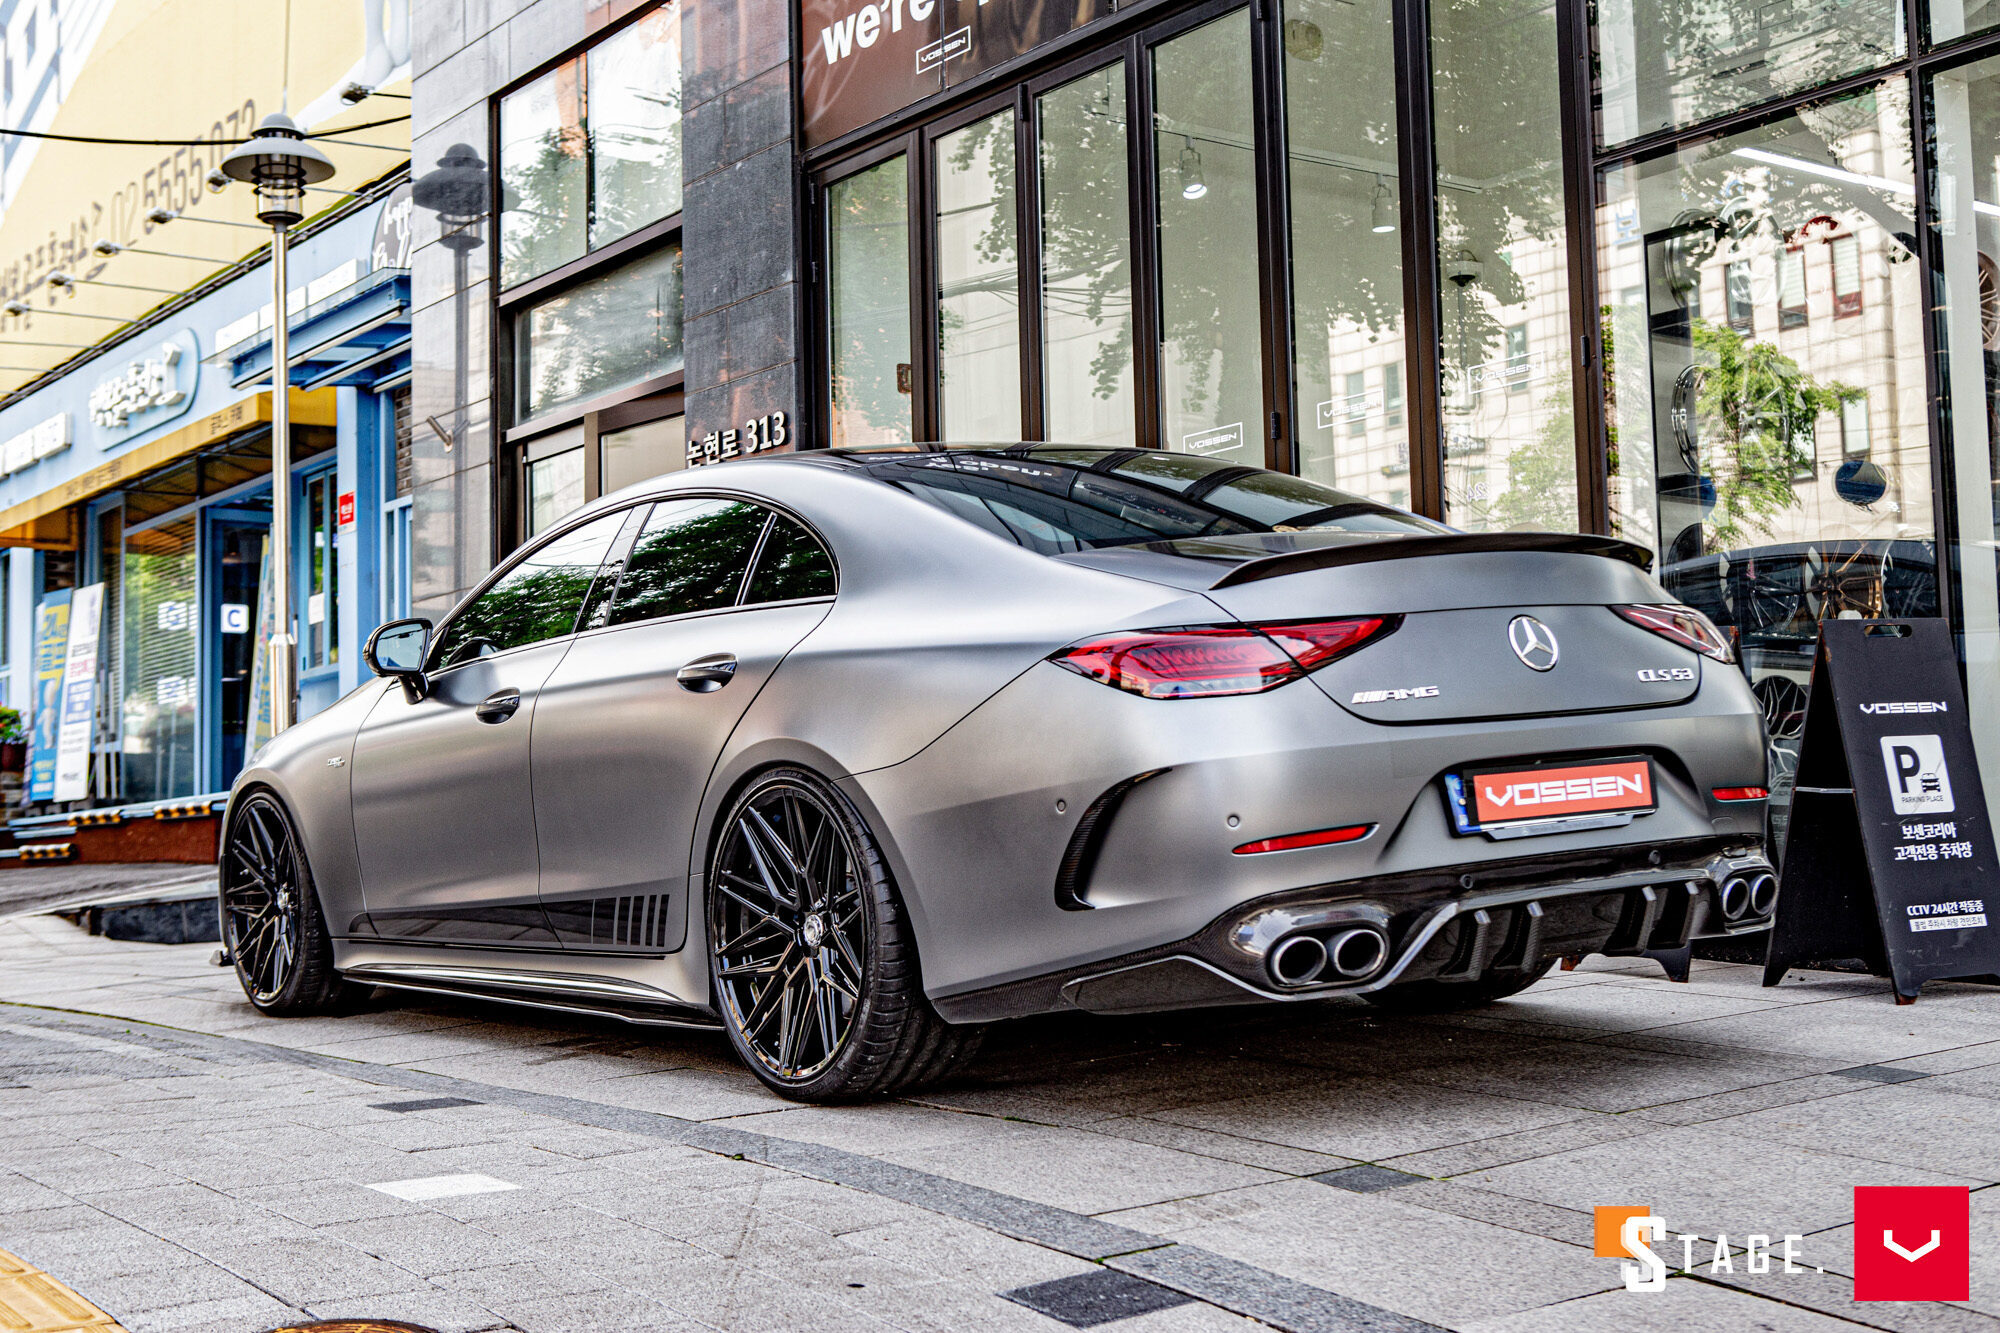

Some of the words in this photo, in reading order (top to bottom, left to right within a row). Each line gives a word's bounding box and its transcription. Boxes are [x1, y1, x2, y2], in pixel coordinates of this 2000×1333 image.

[920, 36, 966, 63] VOSSEN
[1475, 362, 1539, 382] VOSSEN
[1323, 399, 1382, 418] VOSSEN
[686, 428, 739, 468] 논현로
[745, 411, 786, 453] 313
[1189, 431, 1237, 450] VOSSEN
[227, 609, 240, 627] C
[1637, 669, 1670, 682] CLS
[1671, 667, 1695, 680] 53
[1383, 685, 1440, 701] AMG
[1859, 701, 1947, 714] VOSSEN
[1892, 745, 1920, 794] P
[1485, 773, 1643, 807] VOSSEN
[1902, 822, 1957, 840] 보센코리아
[1894, 844, 1938, 861] 고객전용
[1939, 841, 1973, 859] 주차장
[1907, 904, 1931, 916] CCTV
[1931, 902, 1959, 915] 24시간
[1959, 900, 1984, 913] 작동중
